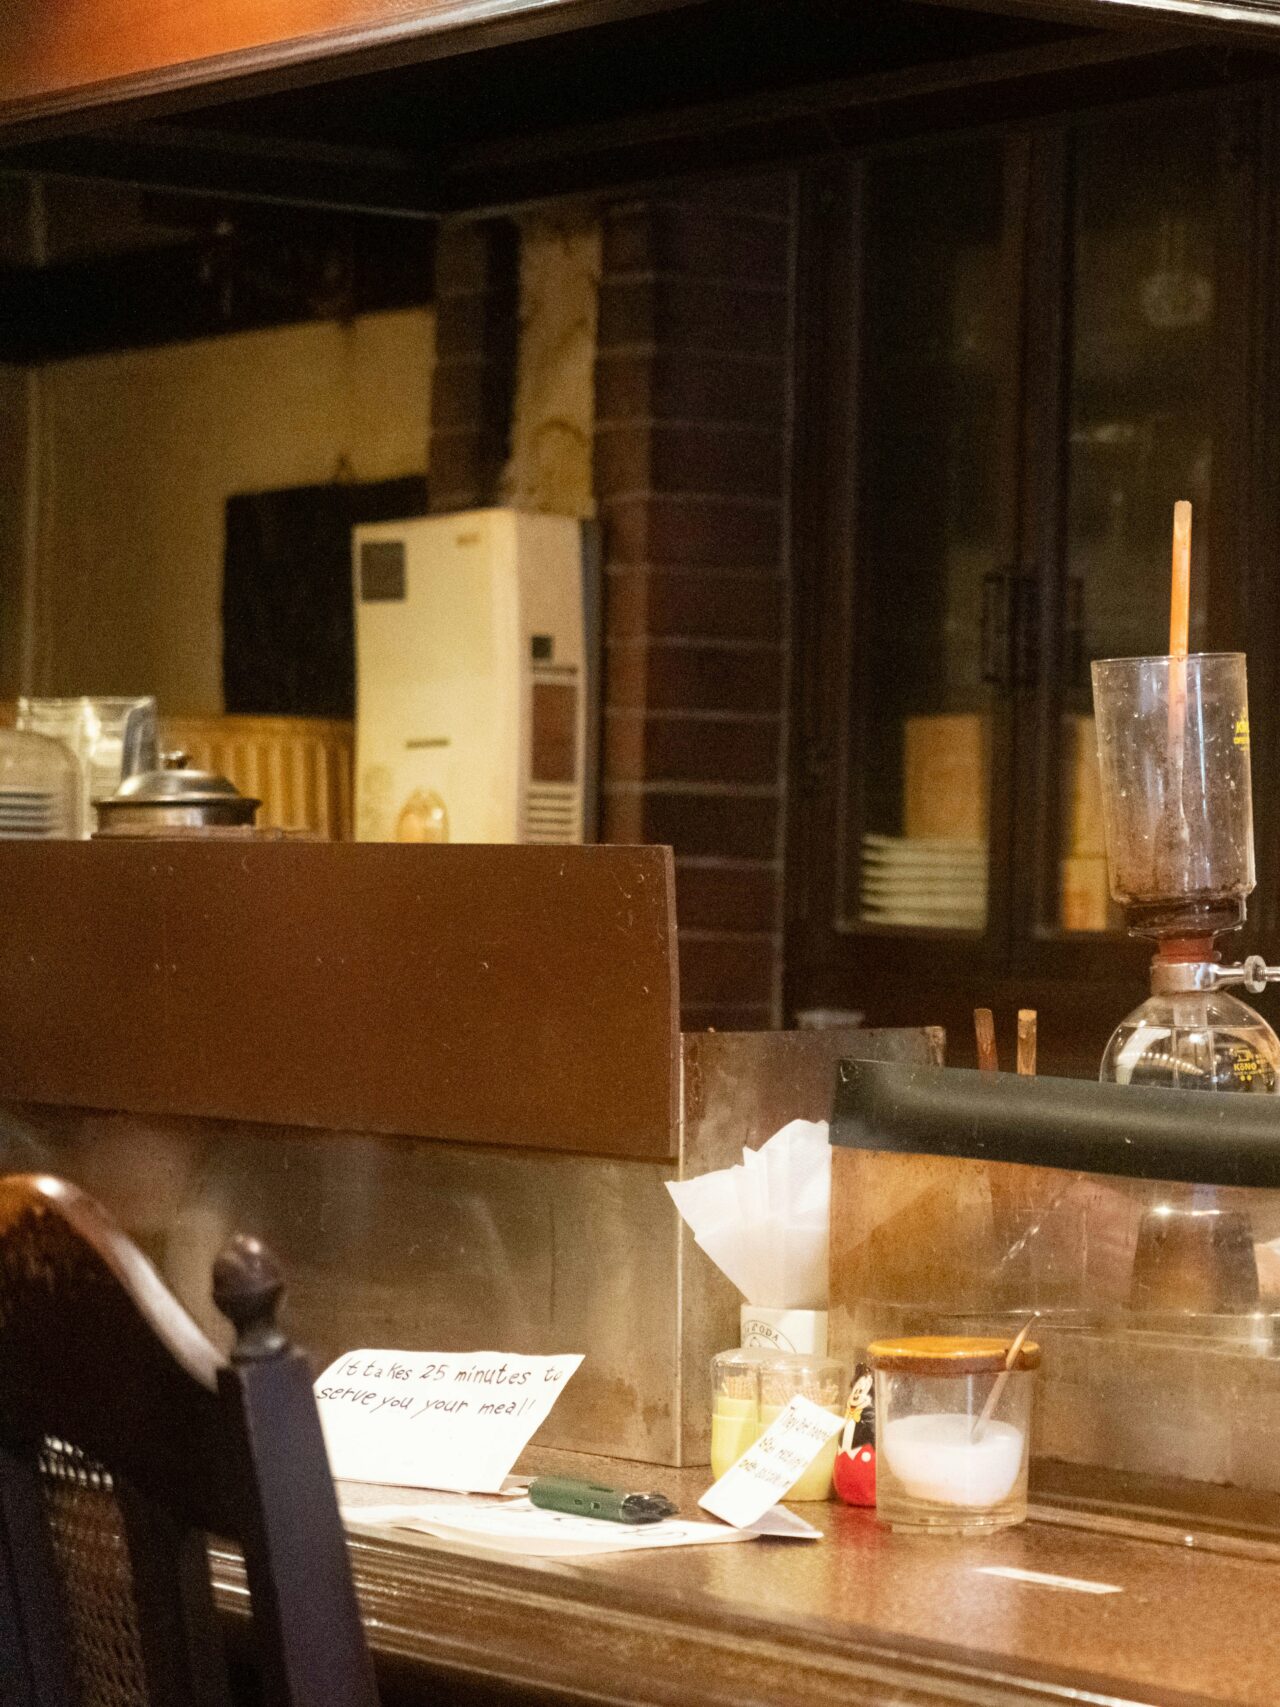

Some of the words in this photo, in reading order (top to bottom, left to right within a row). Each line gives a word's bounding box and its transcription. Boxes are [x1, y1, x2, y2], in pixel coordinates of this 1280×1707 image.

[337, 1357, 360, 1376] It
[419, 1364, 449, 1381] 25
[454, 1363, 532, 1385] minutes
[316, 1387, 377, 1406] serve
[369, 1395, 414, 1414] you
[410, 1399, 469, 1420] your
